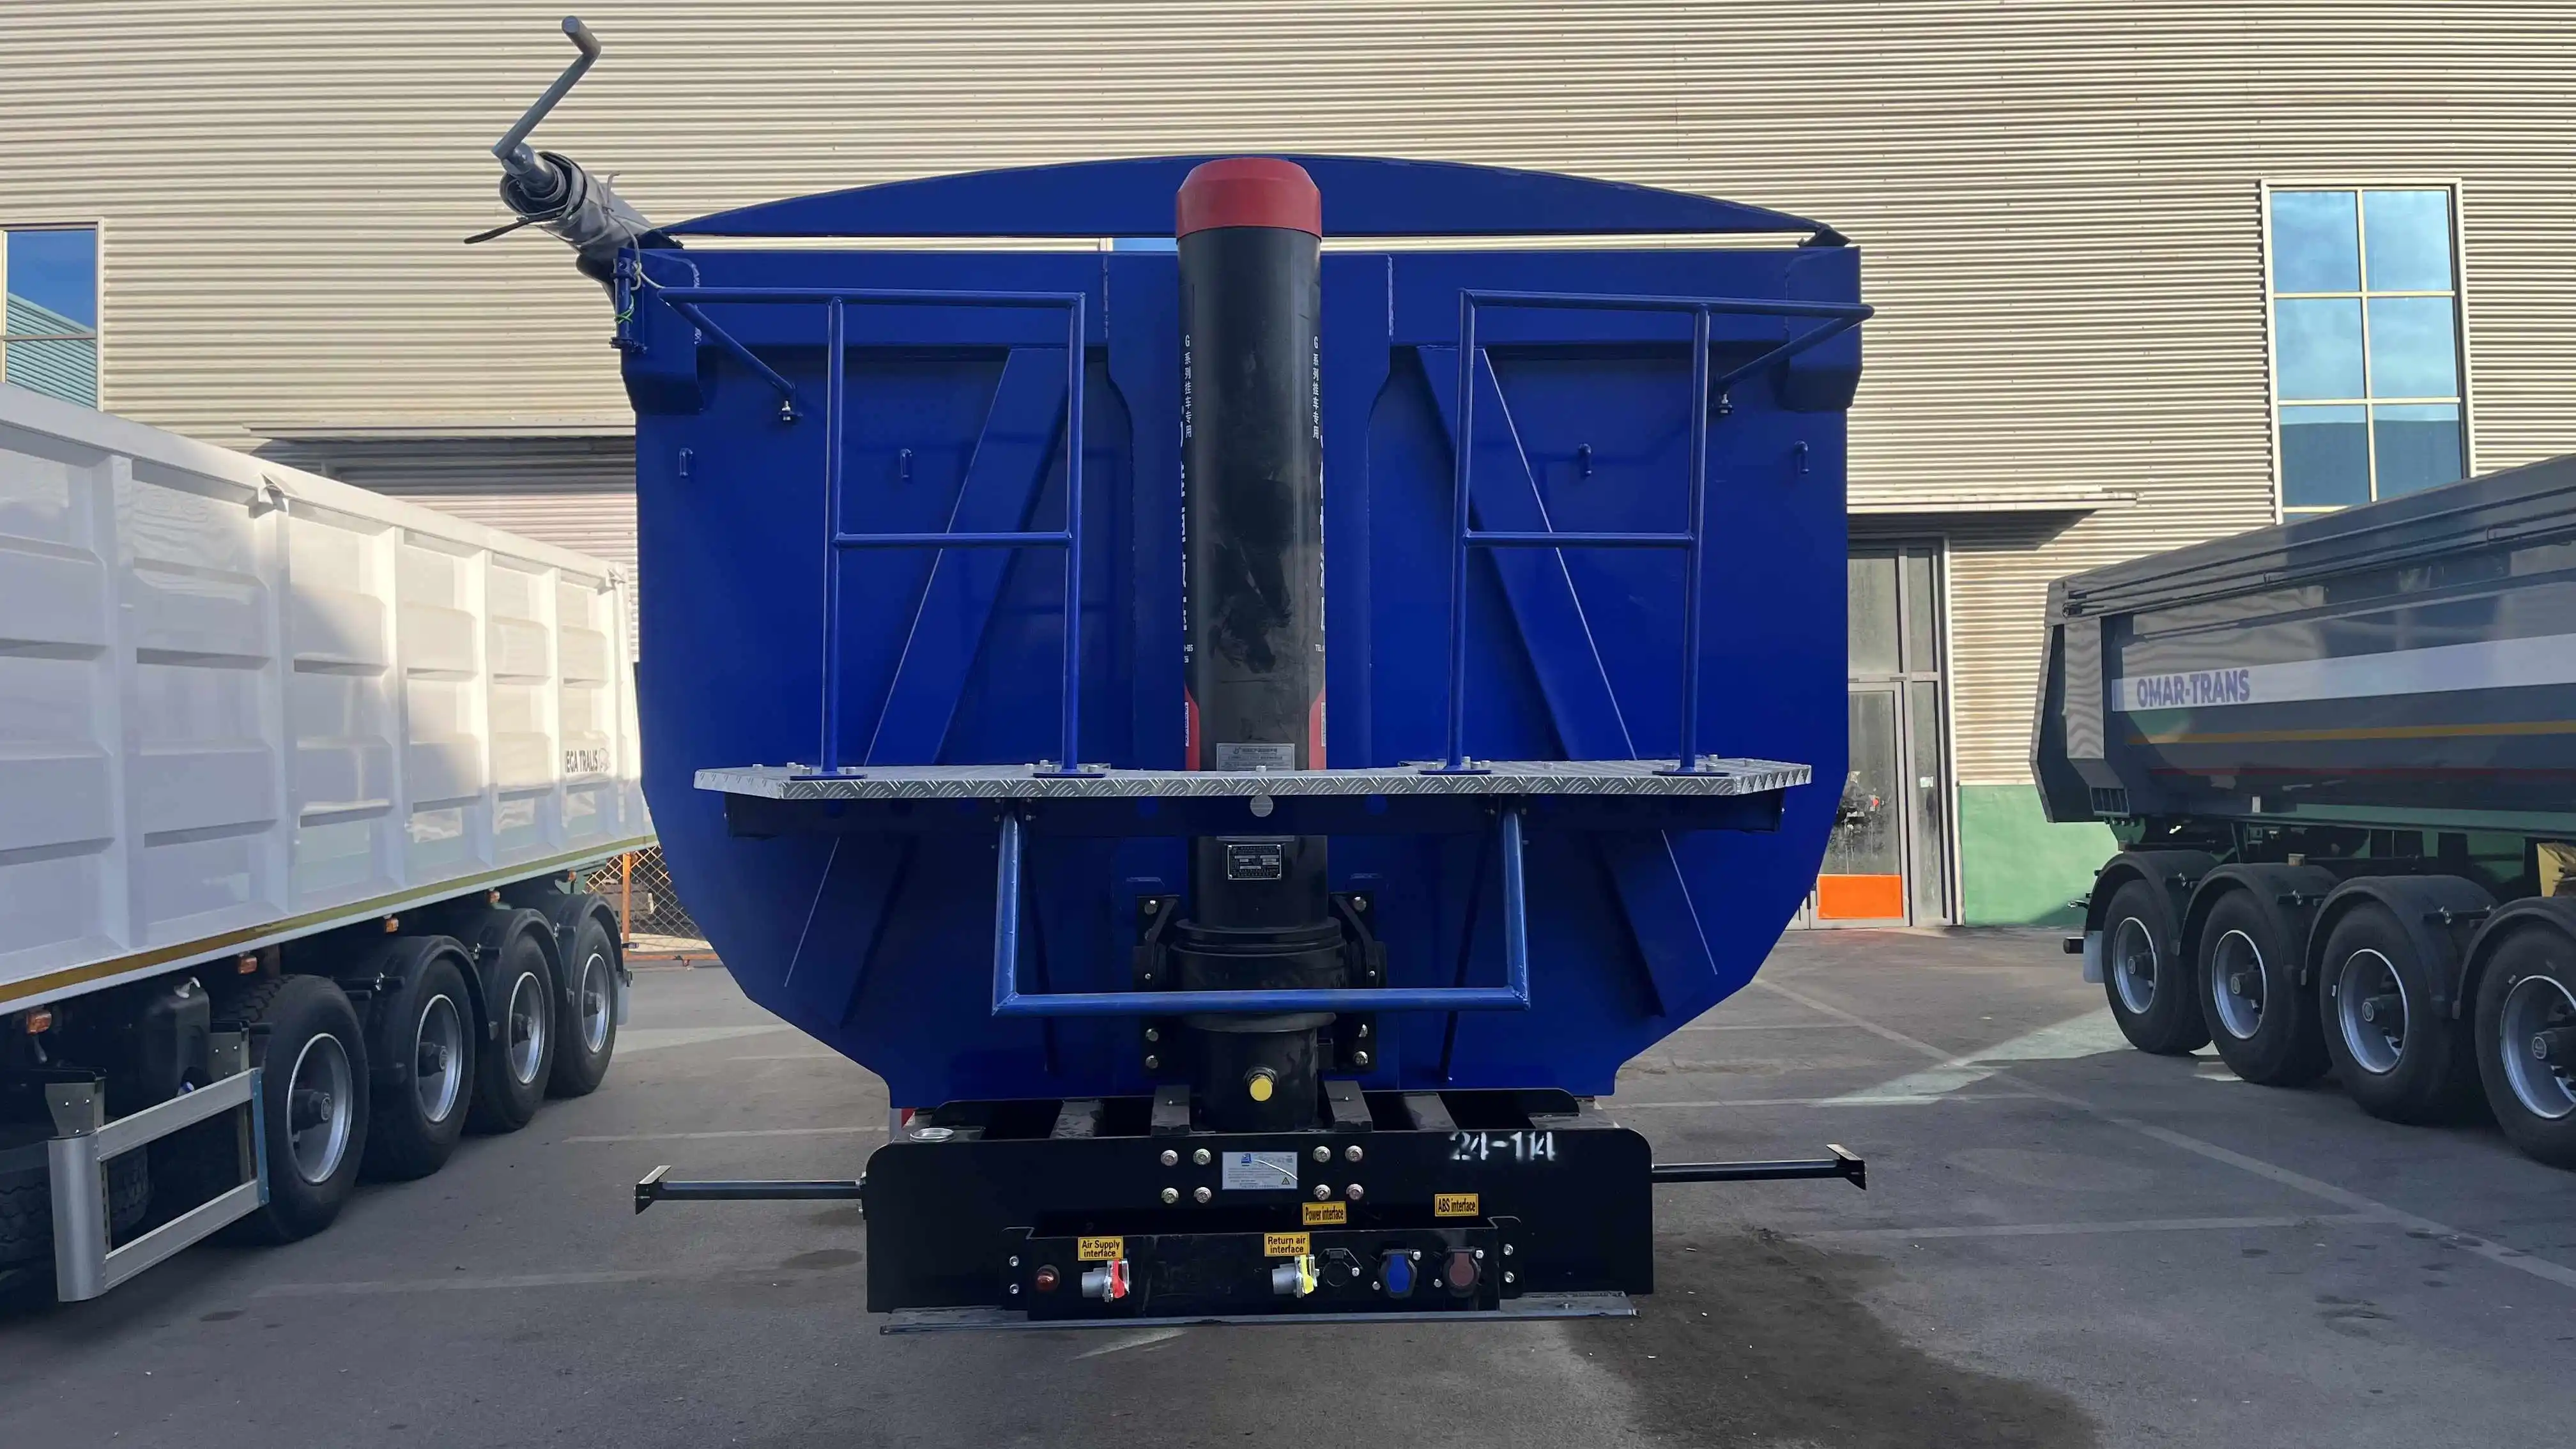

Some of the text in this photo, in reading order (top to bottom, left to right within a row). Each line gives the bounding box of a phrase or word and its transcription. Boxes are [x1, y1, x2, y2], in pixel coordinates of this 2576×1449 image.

[2137, 669, 2251, 707] OMAR-TRANS
[565, 750, 578, 773] EGA
[1438, 1198, 1476, 1213] ABS interface
[1305, 1206, 1344, 1221] Power interface
[1082, 1239, 1121, 1250] Air Supply
[1268, 1236, 1306, 1245] Return air
[1084, 1249, 1116, 1257] interface
[1270, 1244, 1304, 1254] interface
